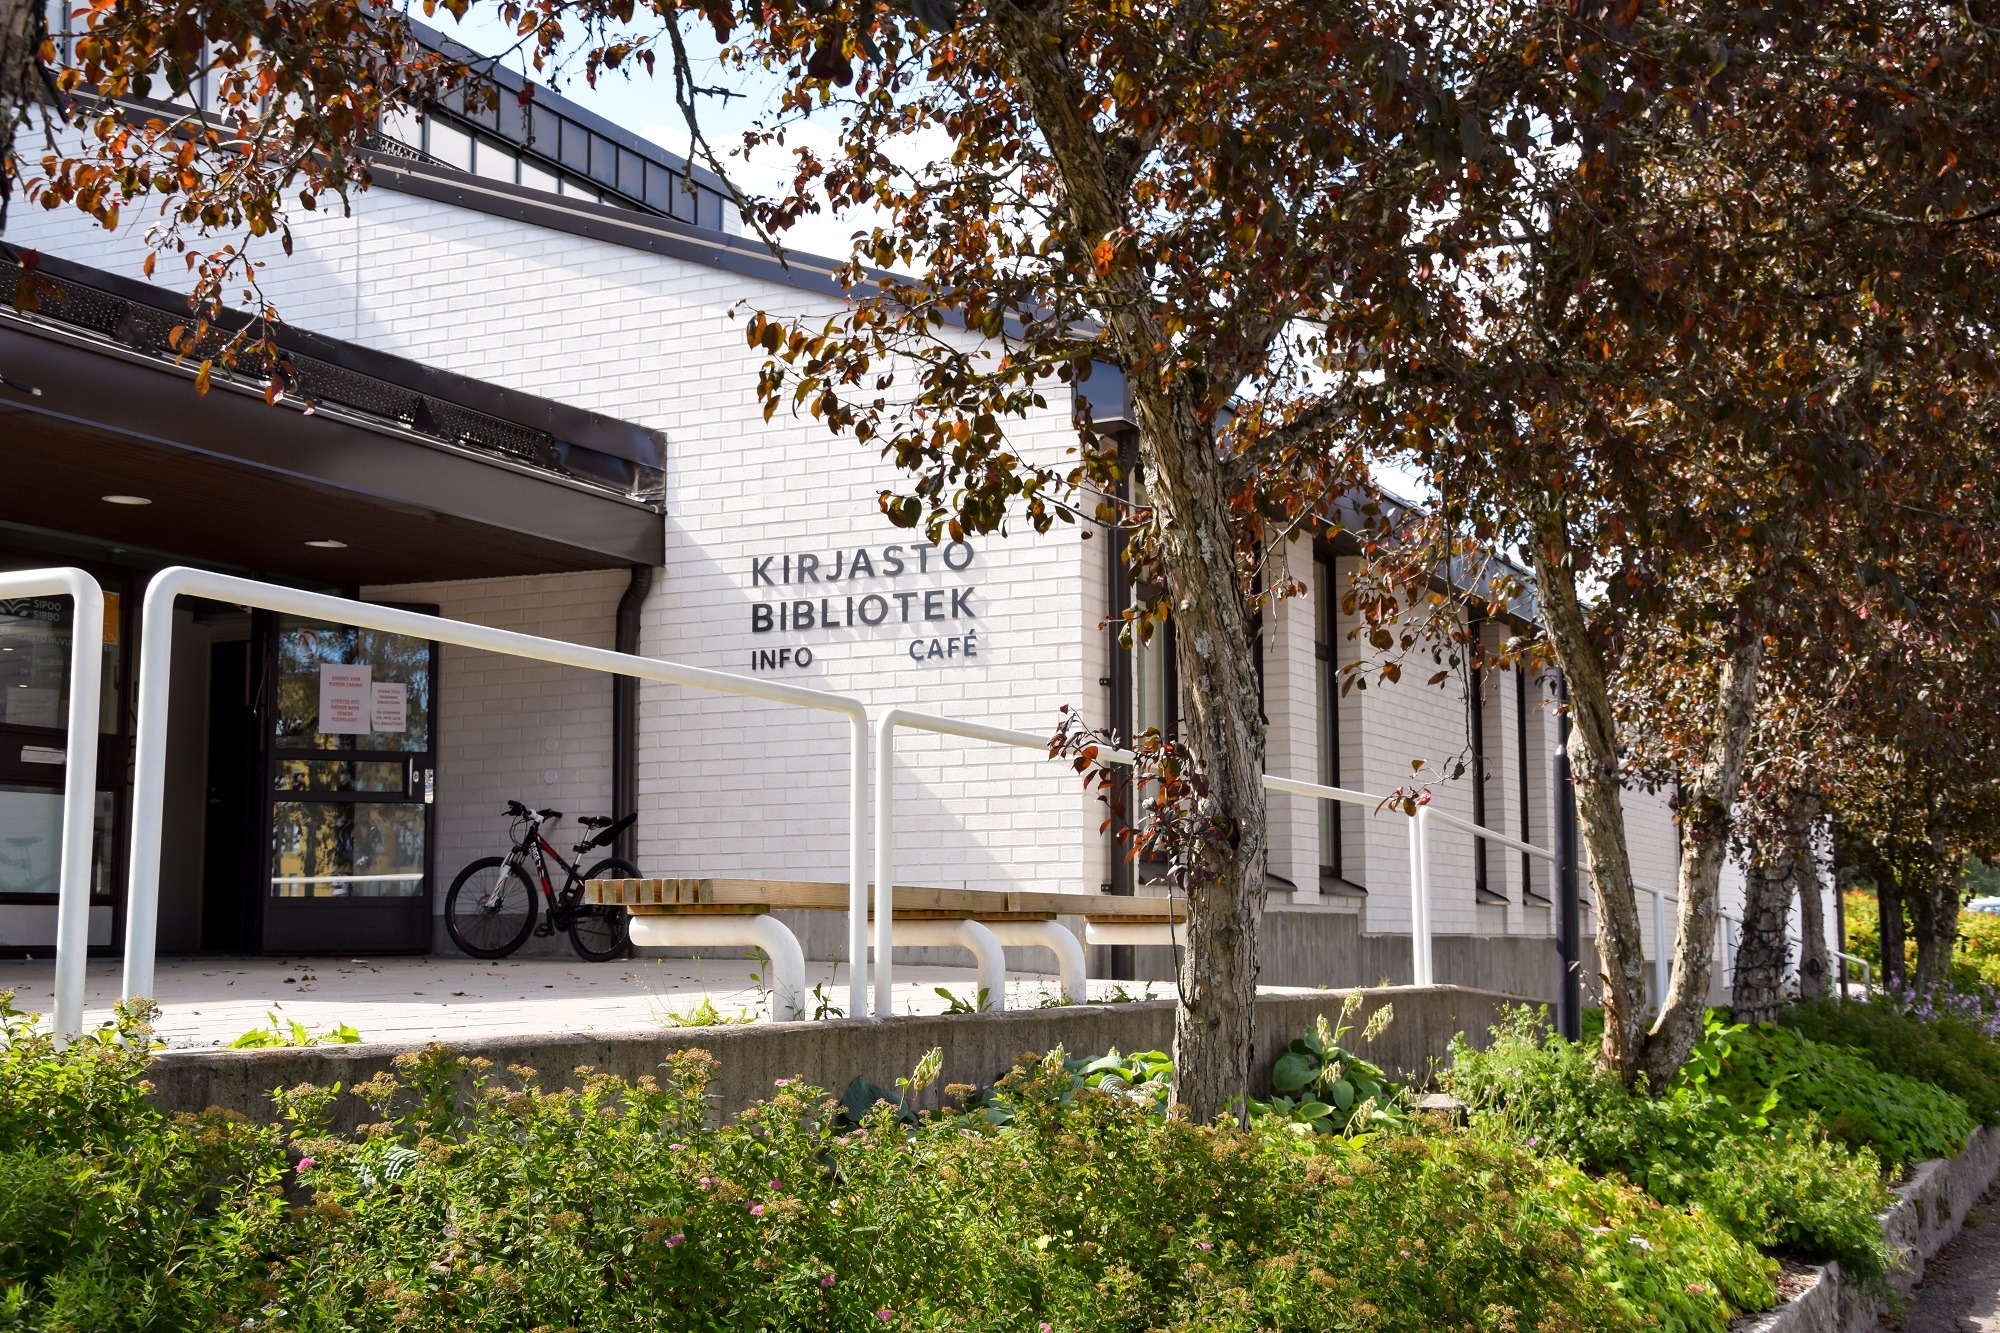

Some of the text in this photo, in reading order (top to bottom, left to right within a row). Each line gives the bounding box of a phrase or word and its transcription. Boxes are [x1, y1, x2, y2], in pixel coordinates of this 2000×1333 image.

[752, 541, 974, 586] KIRJASTO
[33, 610, 60, 622] SIBBO
[34, 599, 62, 612] SIPOO
[752, 587, 976, 632] BIBLIOTEK
[752, 646, 813, 670] INFO
[909, 629, 977, 661] CAFÉ
